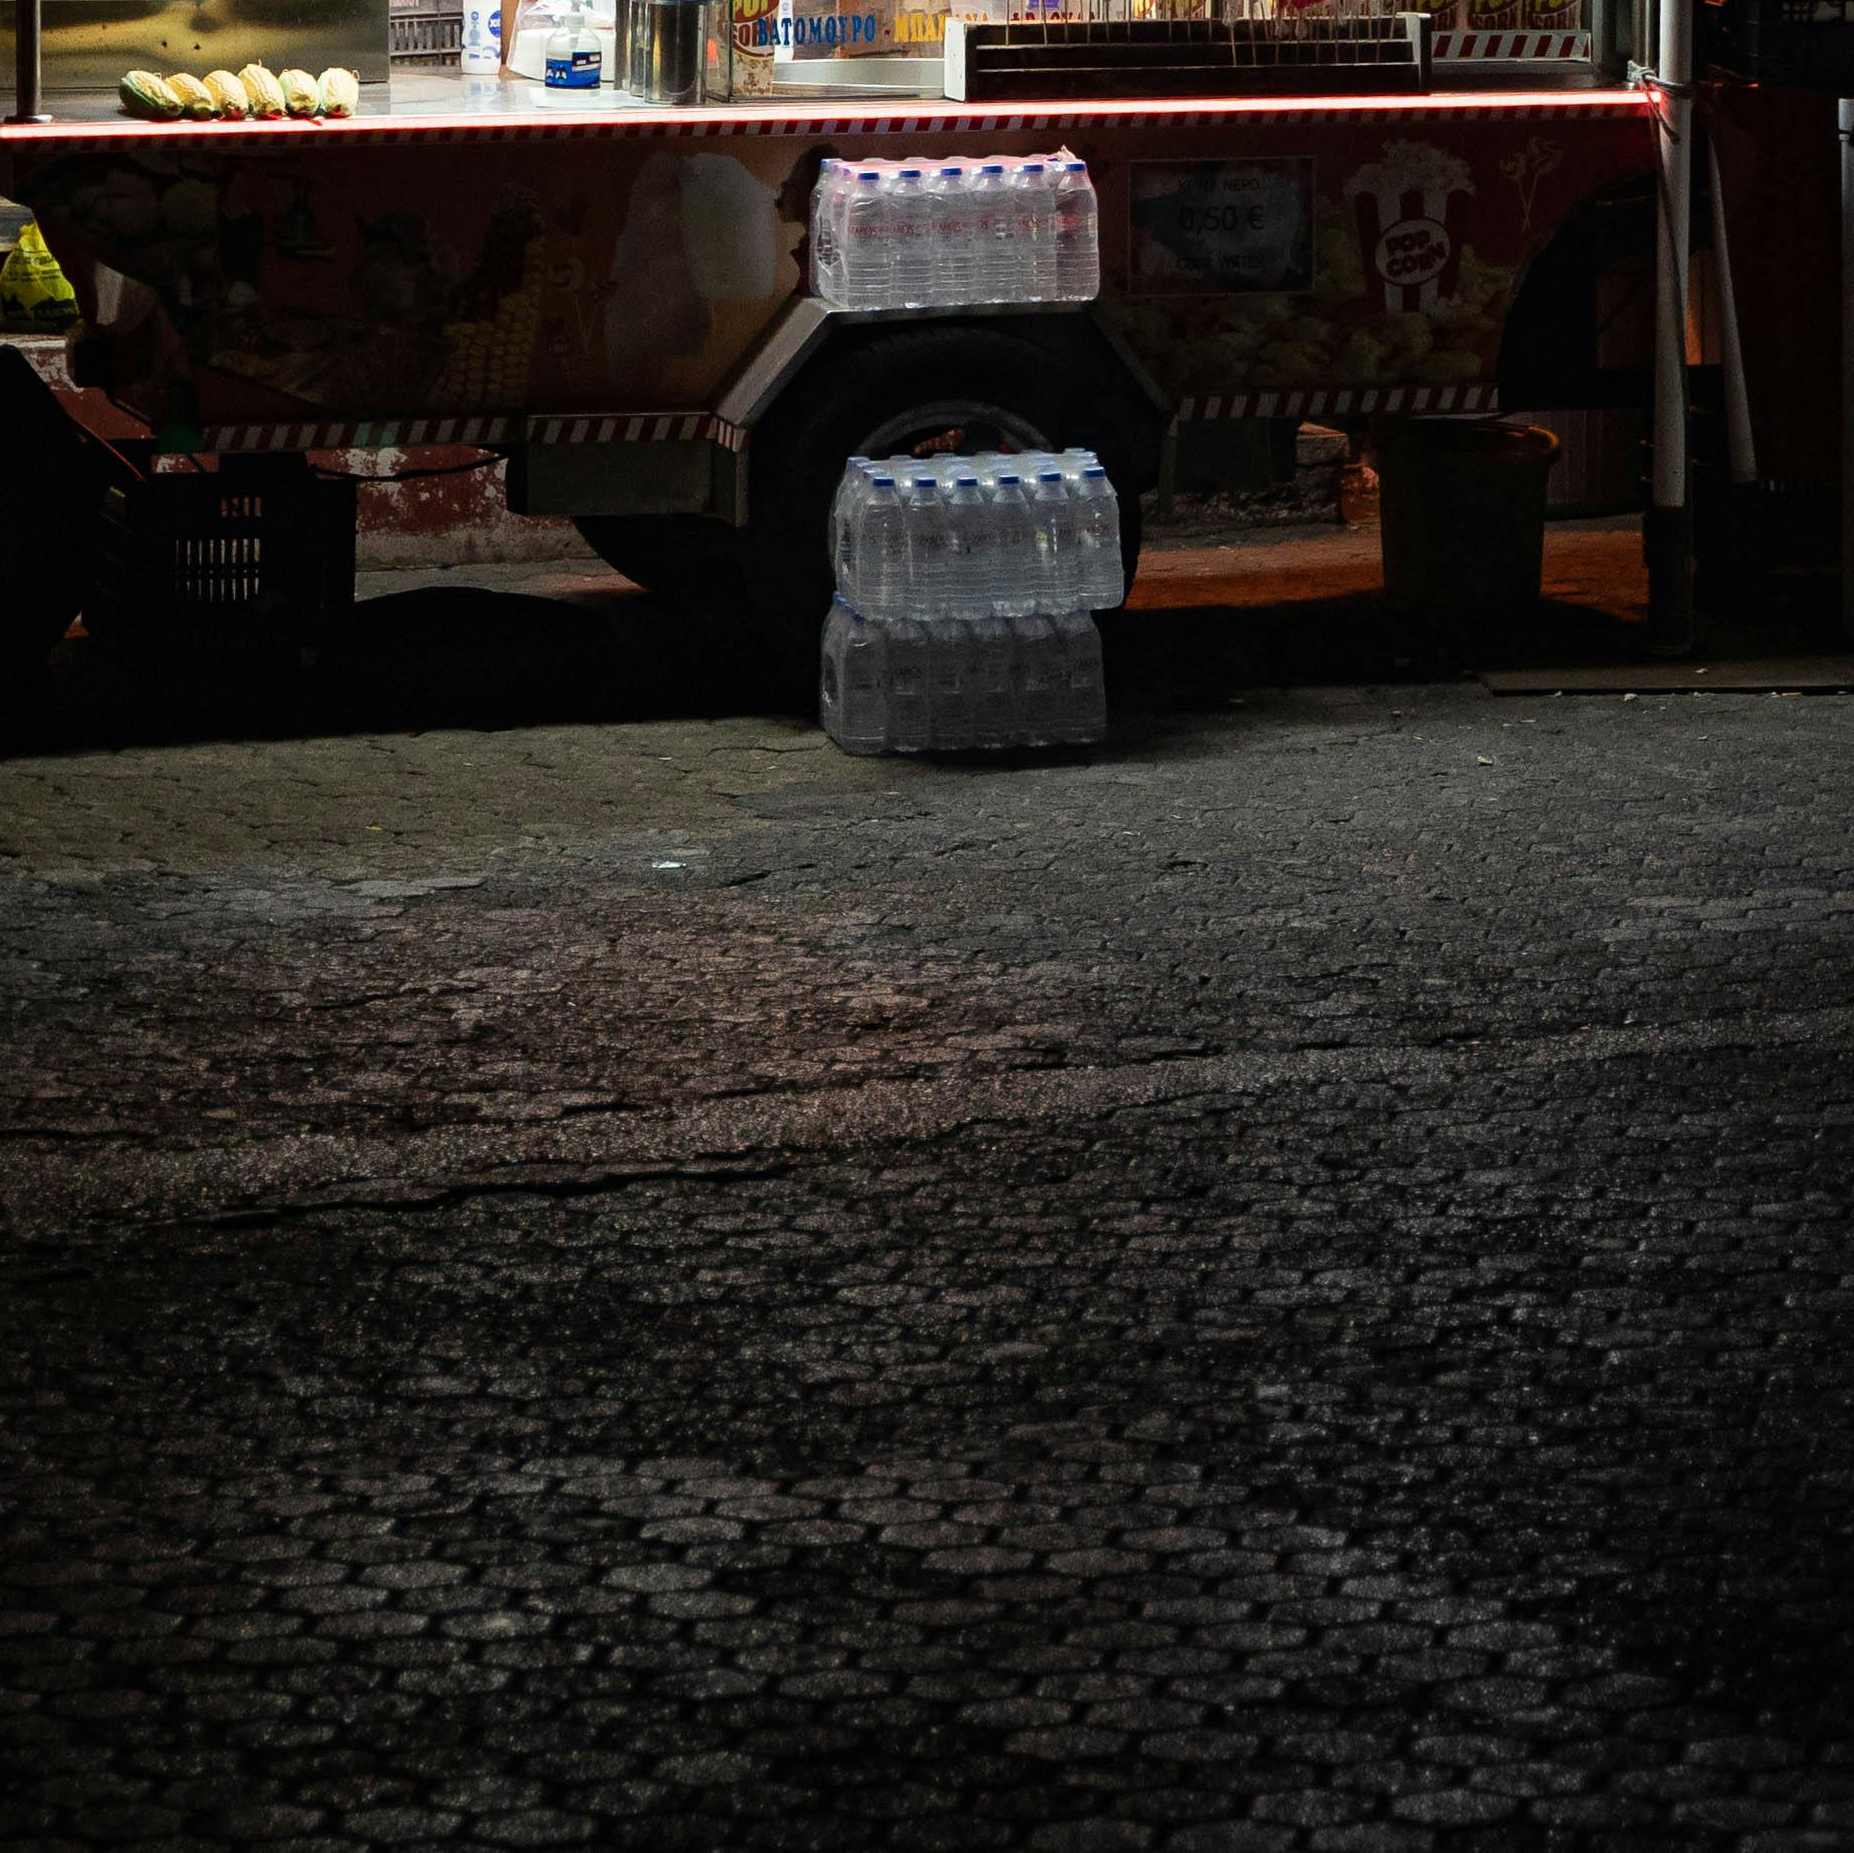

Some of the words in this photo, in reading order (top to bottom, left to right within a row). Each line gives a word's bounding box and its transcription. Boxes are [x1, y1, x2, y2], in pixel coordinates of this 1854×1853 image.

[1179, 205, 1238, 236] 0,50
[1385, 229, 1431, 258] POP
[1386, 240, 1447, 278] CORN
